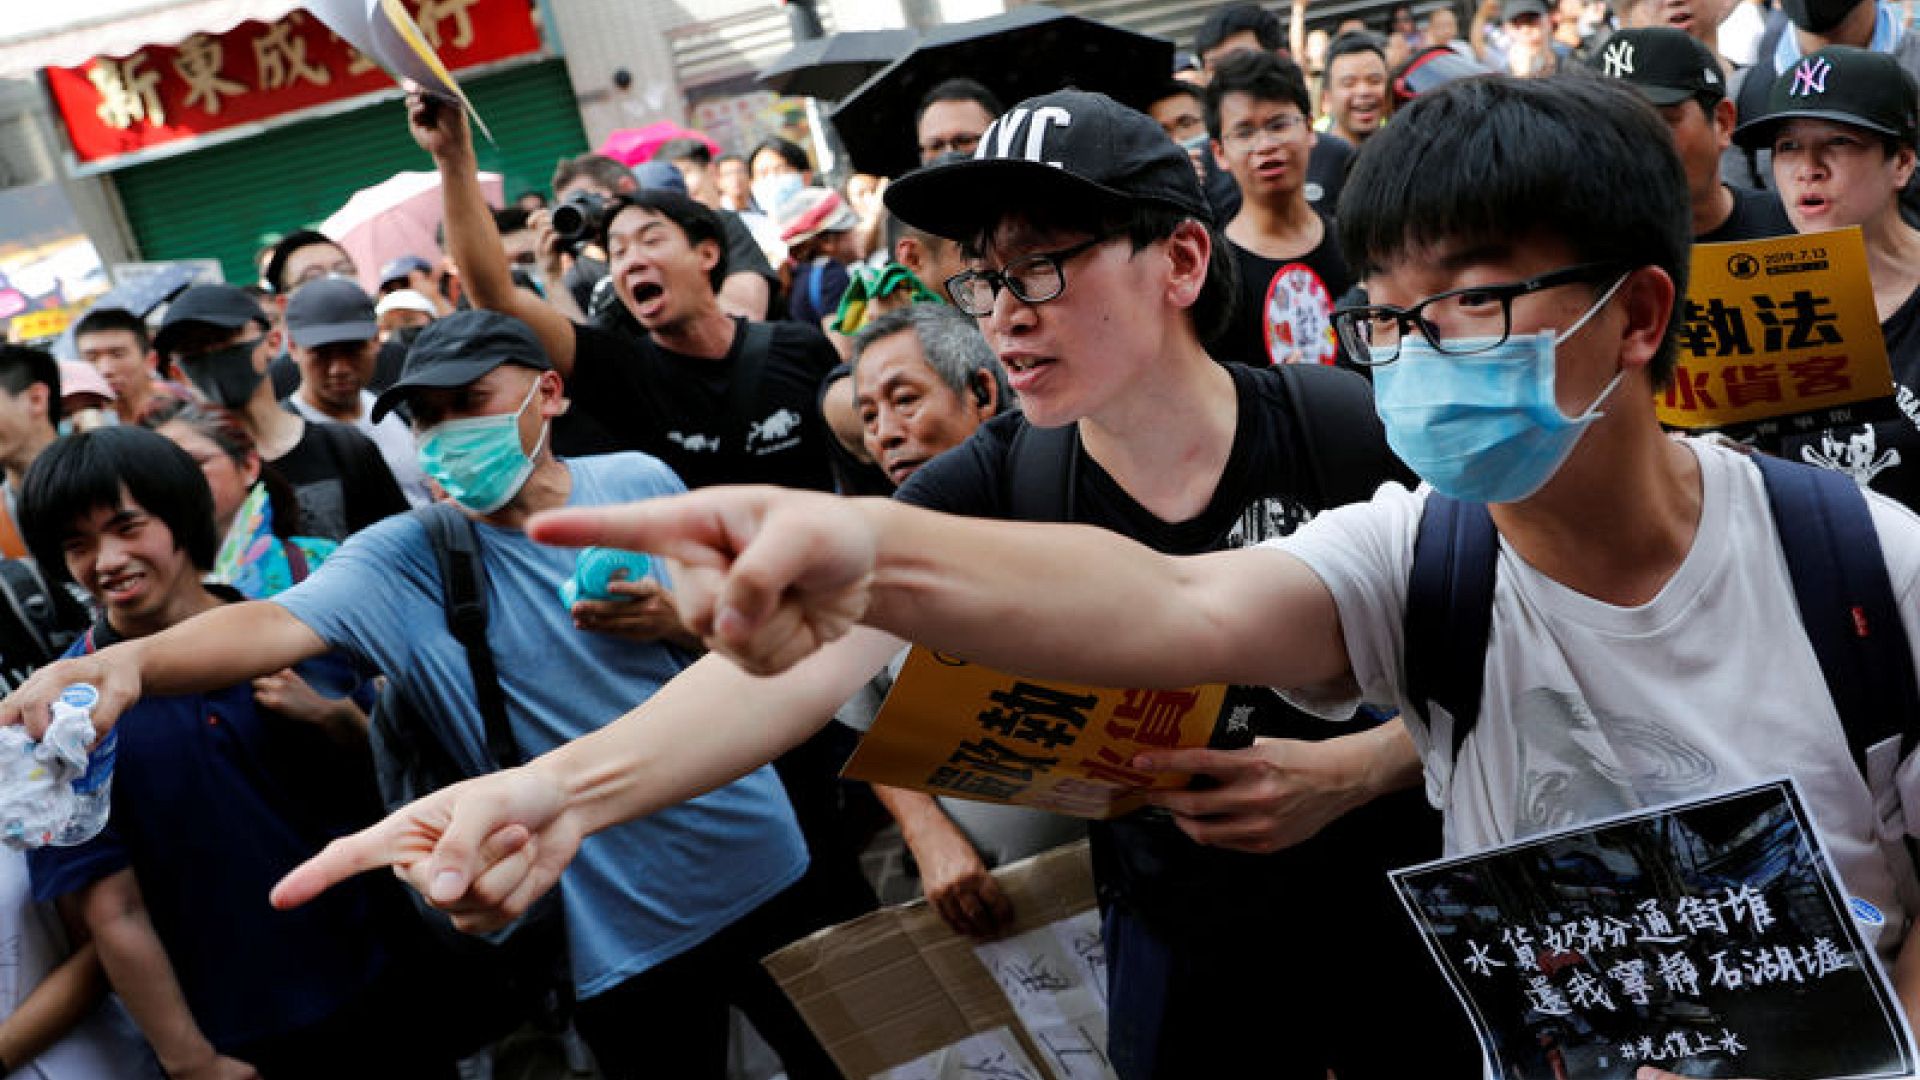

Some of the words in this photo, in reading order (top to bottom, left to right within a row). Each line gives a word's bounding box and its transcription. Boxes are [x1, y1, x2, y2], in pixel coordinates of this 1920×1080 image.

[88, 0, 477, 128] 新東成行
[1603, 39, 1635, 78] NY
[1790, 57, 1831, 96] NY
